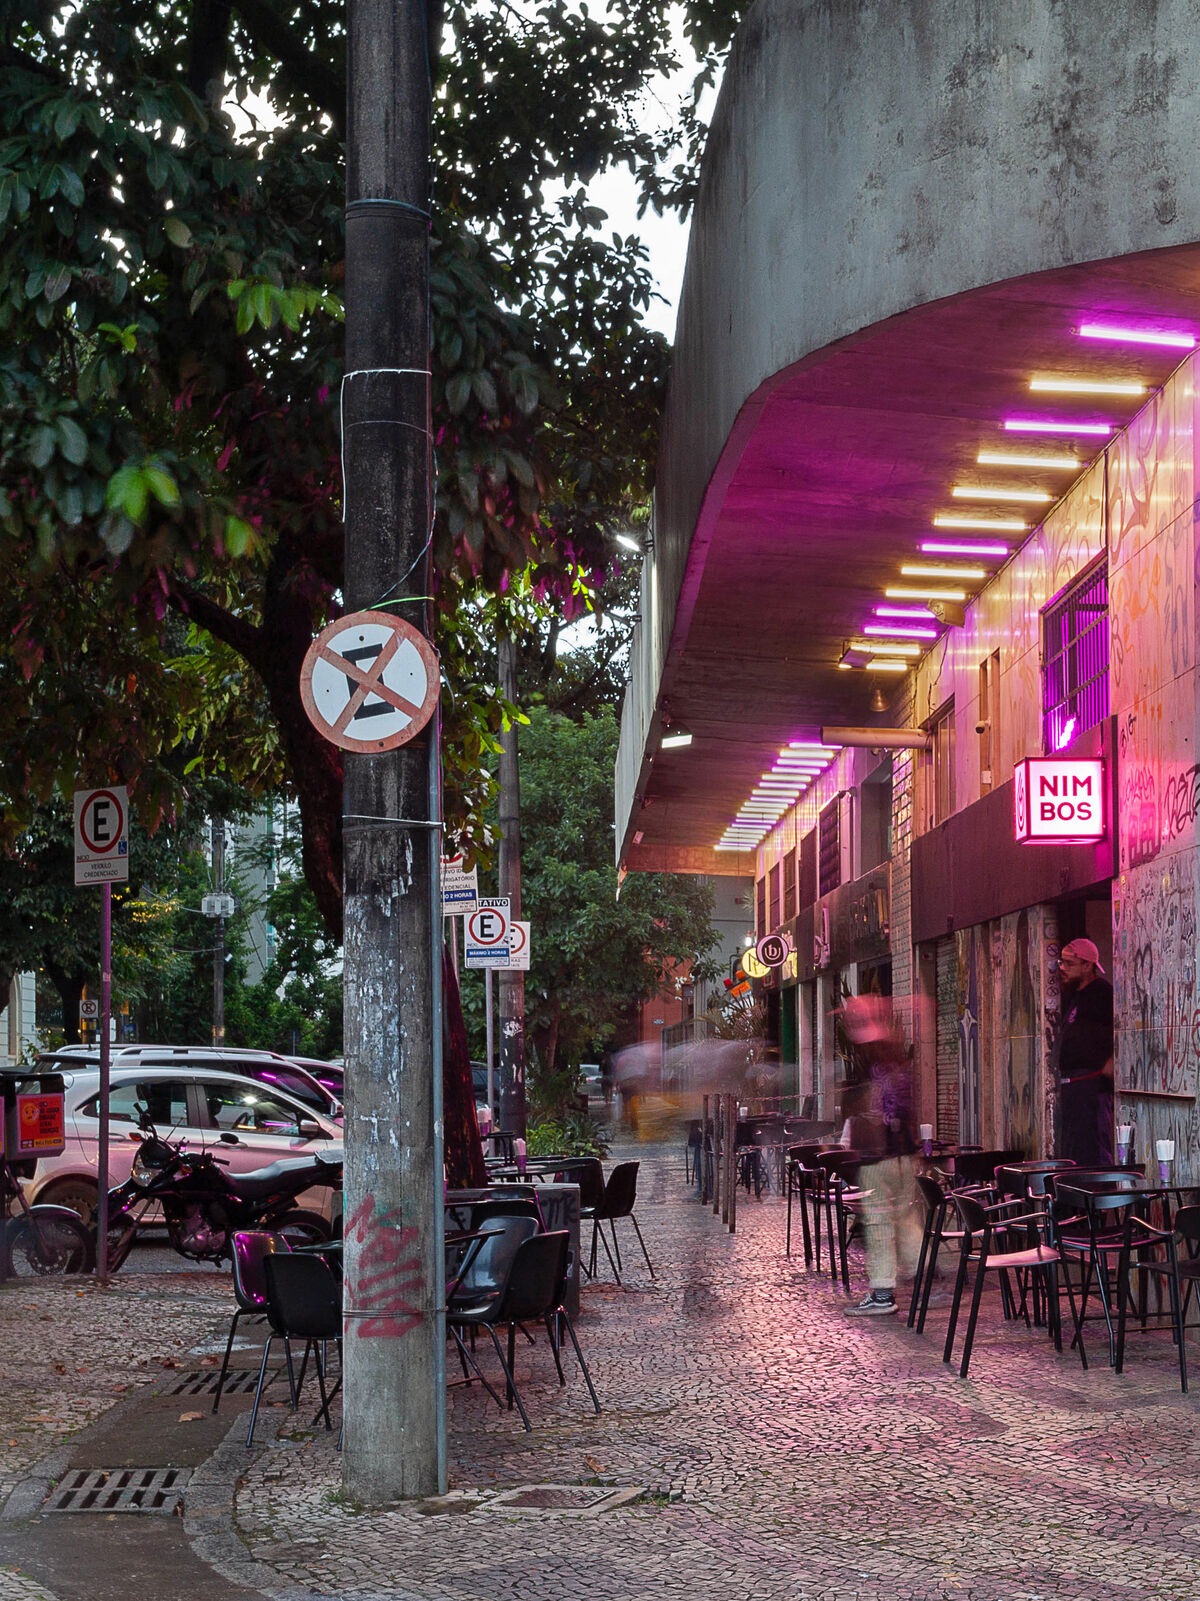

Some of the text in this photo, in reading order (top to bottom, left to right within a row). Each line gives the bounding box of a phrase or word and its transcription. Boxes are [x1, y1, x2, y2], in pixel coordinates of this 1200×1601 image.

[1039, 775, 1093, 797] NIM
[93, 801, 110, 842] E
[1040, 802, 1093, 821] BOS
[480, 914, 494, 938] E
